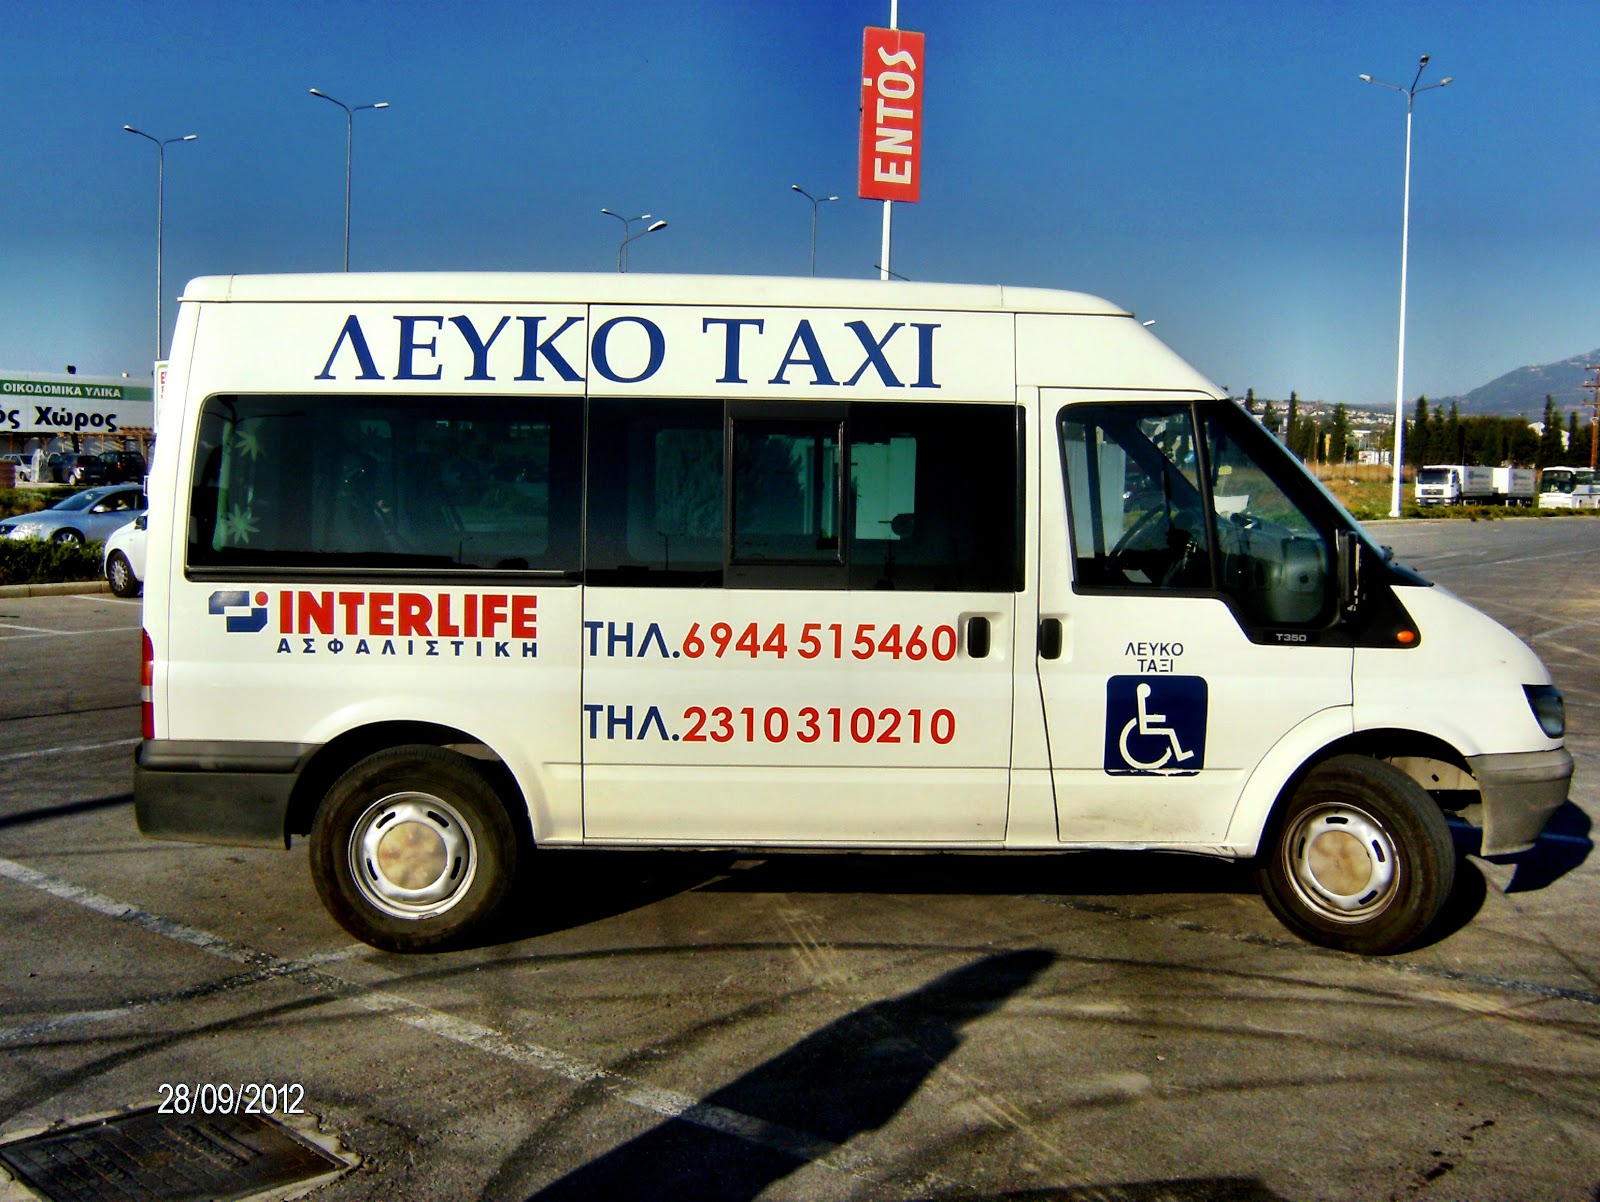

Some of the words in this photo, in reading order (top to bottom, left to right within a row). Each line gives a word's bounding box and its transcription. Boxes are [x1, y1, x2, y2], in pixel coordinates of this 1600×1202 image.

[314, 314, 666, 384] ΛΕΥΚΟ
[3, 383, 82, 396] ΟΙΚΟΔΟΜΙΚΑ
[85, 386, 121, 398] ΥΛΙΚΑ
[35, 406, 117, 432] Χώρος
[279, 590, 538, 639] INTERLIFE
[1276, 633, 1307, 642] T350
[277, 638, 538, 658] ΑΣΦΑΛΙΣΤΙΚΗ
[1125, 642, 1184, 656] ΛΕΥΚΟ
[1137, 659, 1174, 672] ΤΑΞΙ
